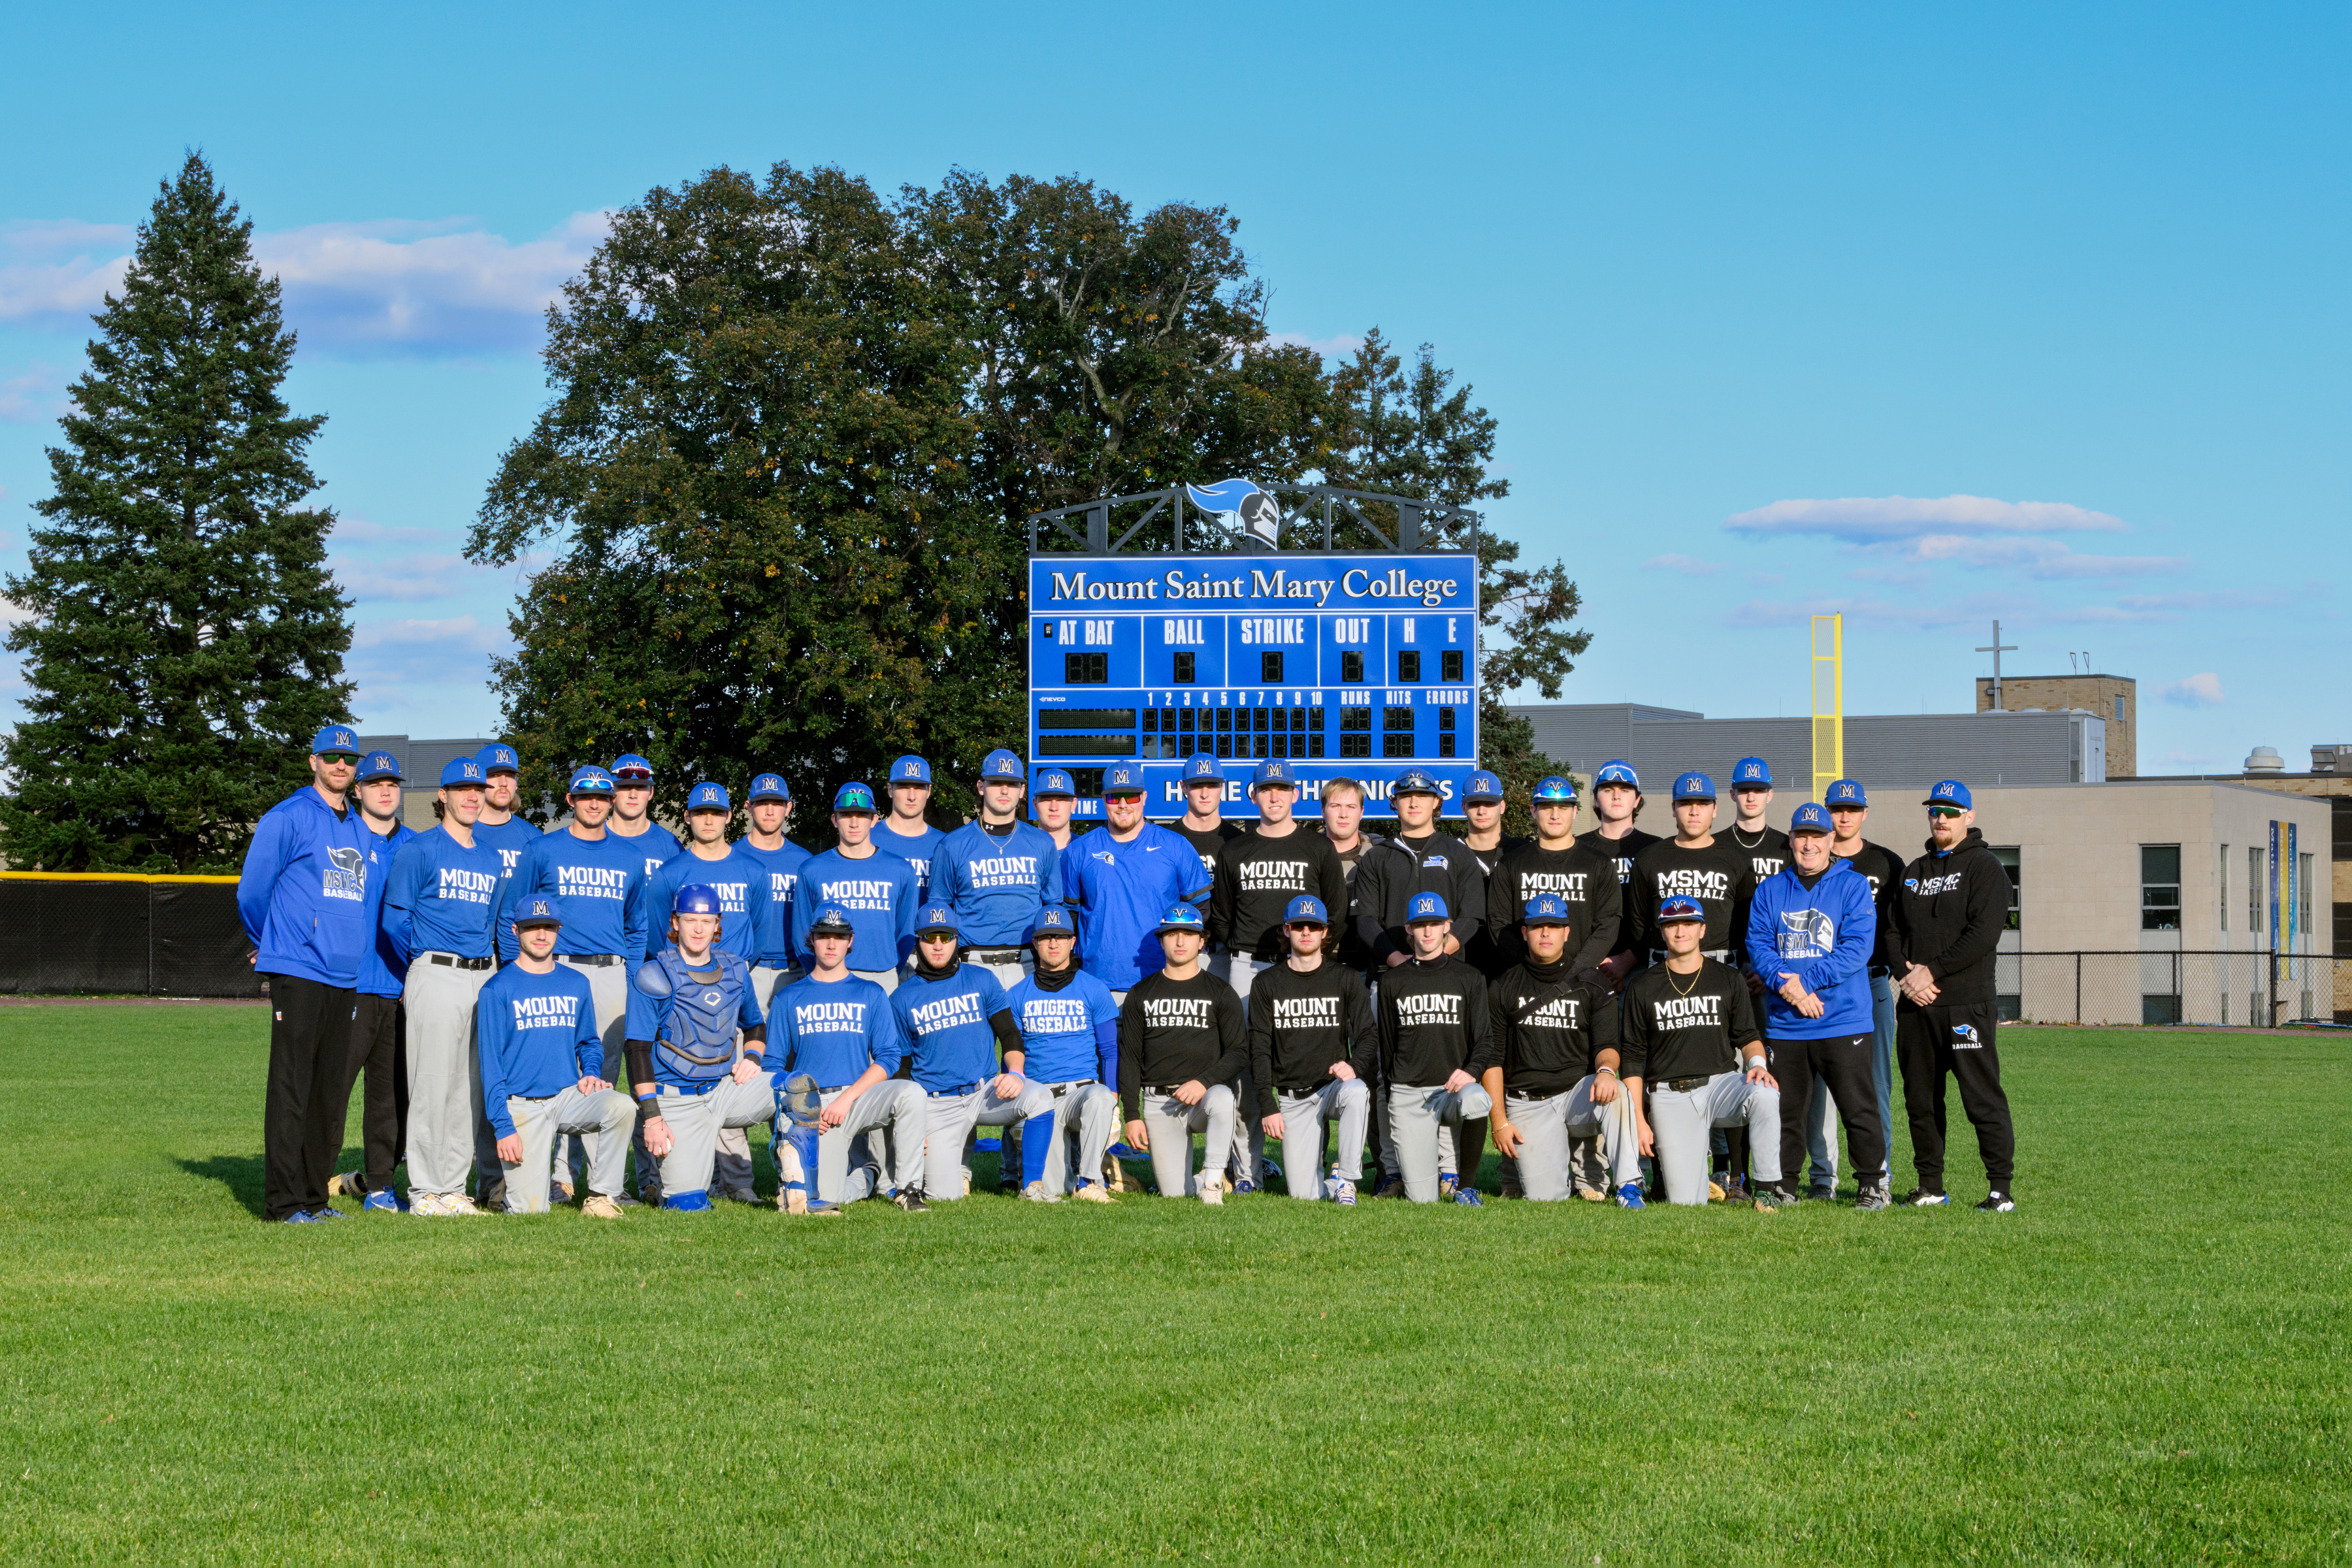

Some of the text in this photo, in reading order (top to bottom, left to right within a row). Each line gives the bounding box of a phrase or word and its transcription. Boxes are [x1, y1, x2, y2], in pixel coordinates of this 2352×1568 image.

[1049, 568, 1458, 608] Mount Saint Mary College
[1058, 620, 1115, 645] AT BAT
[1164, 619, 1205, 644] BALL
[1241, 618, 1304, 644] STRIKE
[1335, 618, 1370, 644] OUT
[1404, 617, 1415, 643] H
[1448, 617, 1456, 643] E
[1147, 691, 1322, 706] 1 2 3 4 5 6 7 8 9 10
[1341, 691, 1370, 705] RUNS
[1386, 691, 1411, 704] HITS
[1426, 690, 1469, 704] ERRORS
[336, 731, 352, 747] M
[376, 756, 393, 770] M
[496, 749, 512, 764] M
[464, 763, 481, 778] M
[906, 762, 921, 777] M
[998, 759, 1014, 774] M
[1196, 760, 1213, 774] M
[1267, 763, 1283, 777] M
[1744, 764, 1761, 778] M
[762, 777, 778, 791] M
[1048, 774, 1064, 789] M
[1114, 770, 1130, 784] M
[1687, 777, 1703, 792] M
[1474, 778, 1490, 792] M
[1838, 784, 1855, 798] M
[1936, 783, 1955, 796] M
[702, 788, 718, 801] M
[1071, 800, 1098, 814] IME
[1801, 808, 1818, 822] M
[970, 857, 1037, 877] MOUNT
[1239, 861, 1309, 879] MOUNT
[440, 868, 497, 894] MOUNT
[558, 866, 627, 889] MOUNT
[972, 874, 1037, 889] BASEBALL
[1241, 879, 1306, 890] BASEBALL
[1521, 873, 1588, 891] MOUNT
[1657, 870, 1728, 890] MSMC
[323, 888, 363, 902] BASEBALL
[439, 888, 491, 905] BASEBALL
[559, 885, 624, 900] BASEBALL
[821, 881, 892, 900] MOUNT
[533, 900, 549, 915] M
[1299, 900, 1316, 915] M
[1418, 898, 1435, 913] M
[1539, 900, 1556, 914] M
[930, 909, 946, 923] M
[1045, 911, 1061, 925] M
[512, 996, 578, 1019] MOUNT
[911, 992, 980, 1025] MOUNT
[1024, 999, 1085, 1017] KNIGHTS
[1144, 998, 1212, 1017] MOUNT
[1273, 997, 1339, 1017] MOUNT
[1396, 994, 1462, 1015] MOUNT
[1654, 996, 1721, 1020] MOUNT
[796, 1002, 866, 1024] MOUNT
[1399, 1013, 1460, 1026] BASEBALL
[516, 1016, 576, 1030] BASEBALL
[798, 1021, 864, 1036] BASEBALL
[917, 1011, 982, 1036] BASEBALL
[1022, 1015, 1087, 1033] BASEBALL
[1145, 1017, 1209, 1028] BASEBALL
[1275, 1017, 1339, 1029] BASEBALL
[1518, 1015, 1578, 1030] ASEBALL
